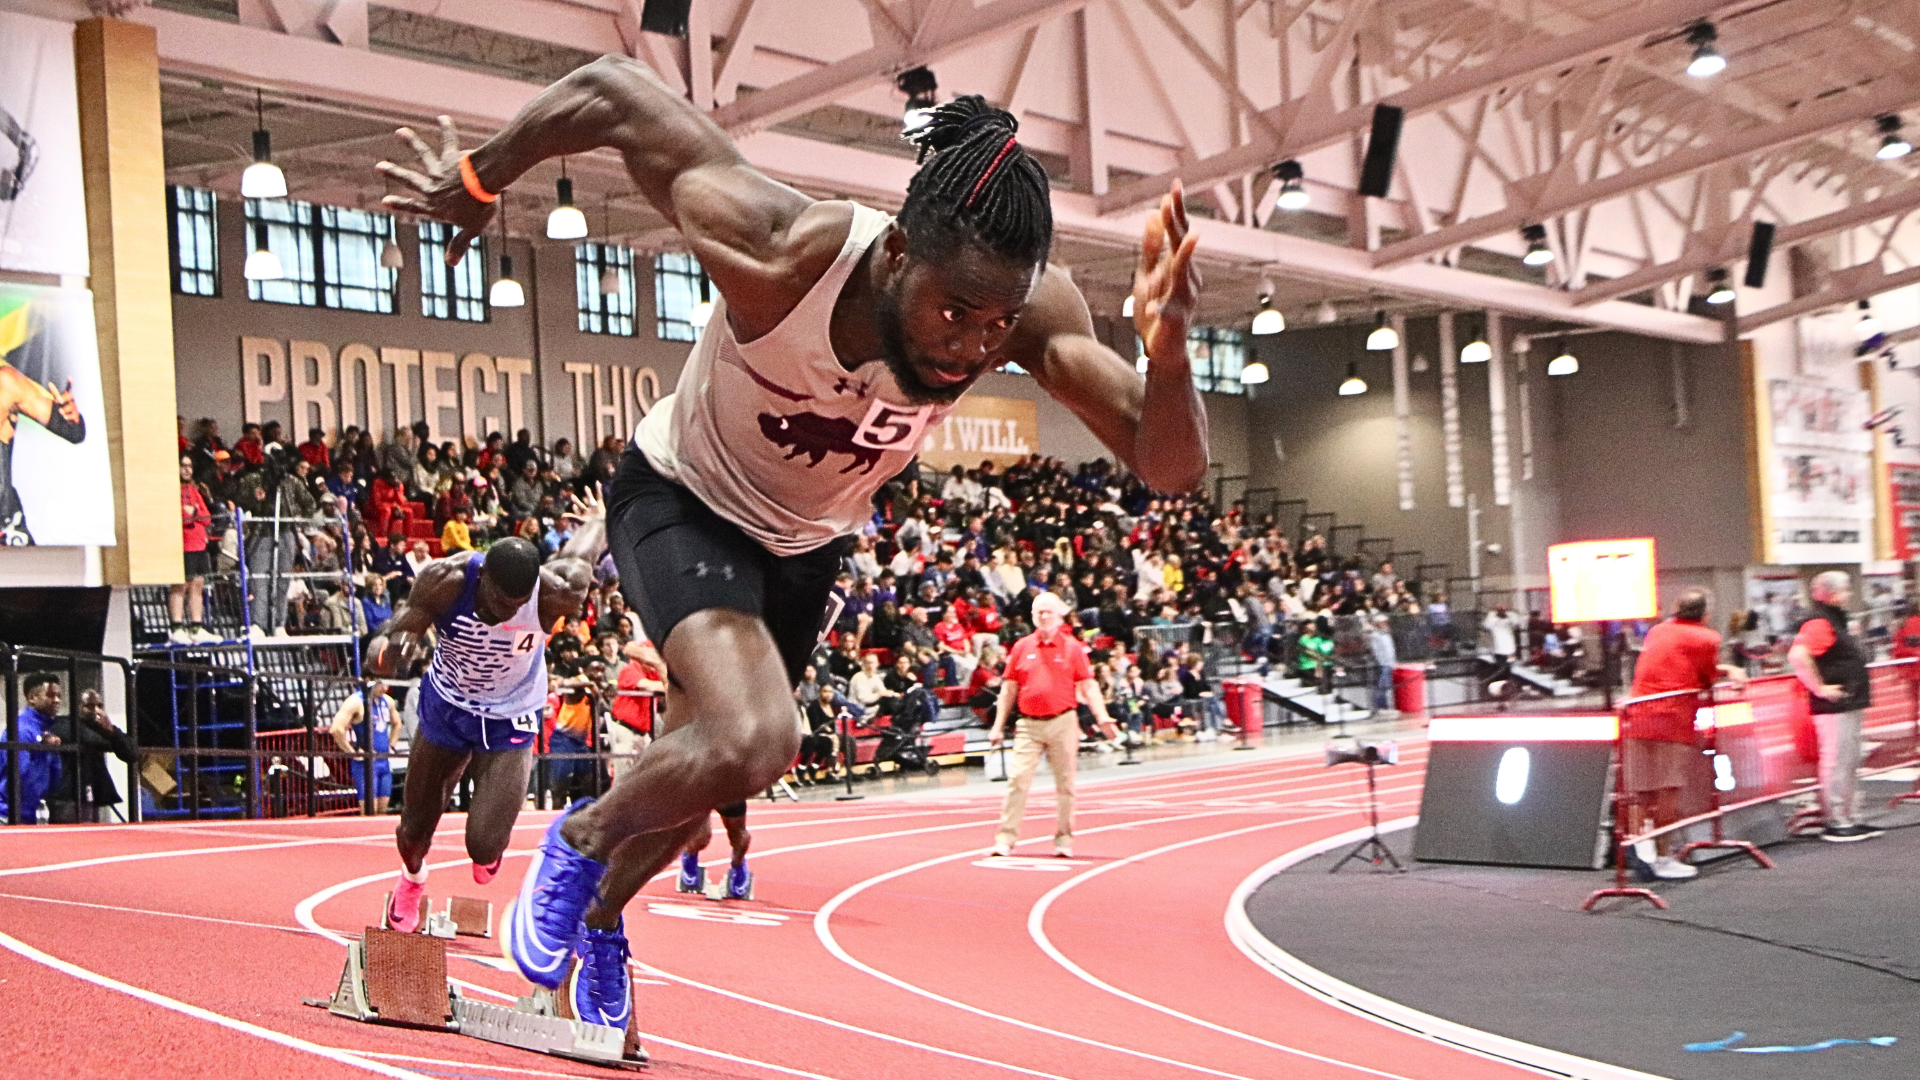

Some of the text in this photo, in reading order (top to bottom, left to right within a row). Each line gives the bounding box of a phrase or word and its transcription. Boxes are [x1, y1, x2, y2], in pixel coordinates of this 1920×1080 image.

[241, 336, 533, 454] PROTECT
[863, 408, 918, 444] 5
[518, 634, 534, 652] 4
[517, 715, 533, 729] 4
